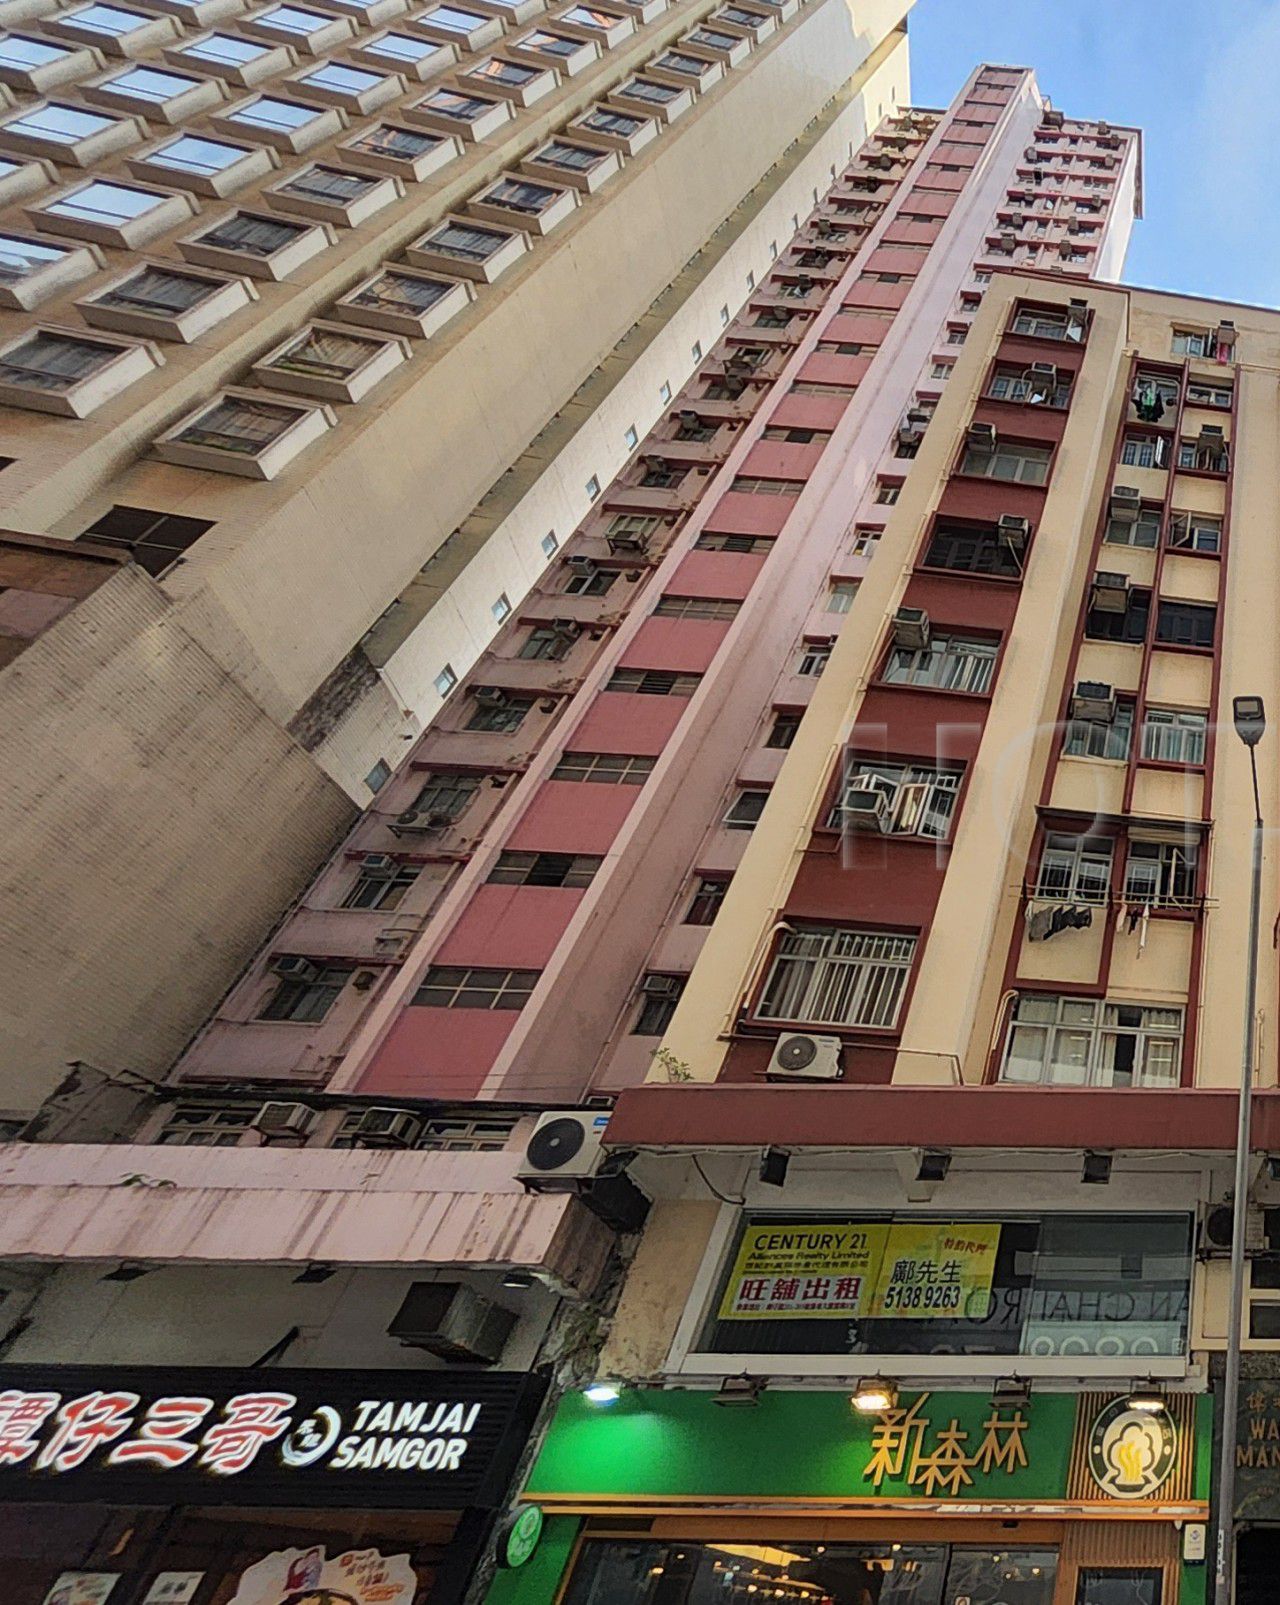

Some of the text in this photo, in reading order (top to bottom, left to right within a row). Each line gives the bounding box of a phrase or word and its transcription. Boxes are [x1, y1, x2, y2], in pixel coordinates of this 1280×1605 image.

[754, 1233, 868, 1250] CENTURY 21
[831, 1251, 869, 1260] Limited
[884, 1286, 961, 1309] 5138 9263
[352, 1401, 482, 1433] TAMJAI
[327, 1436, 468, 1470] SAMGOR
